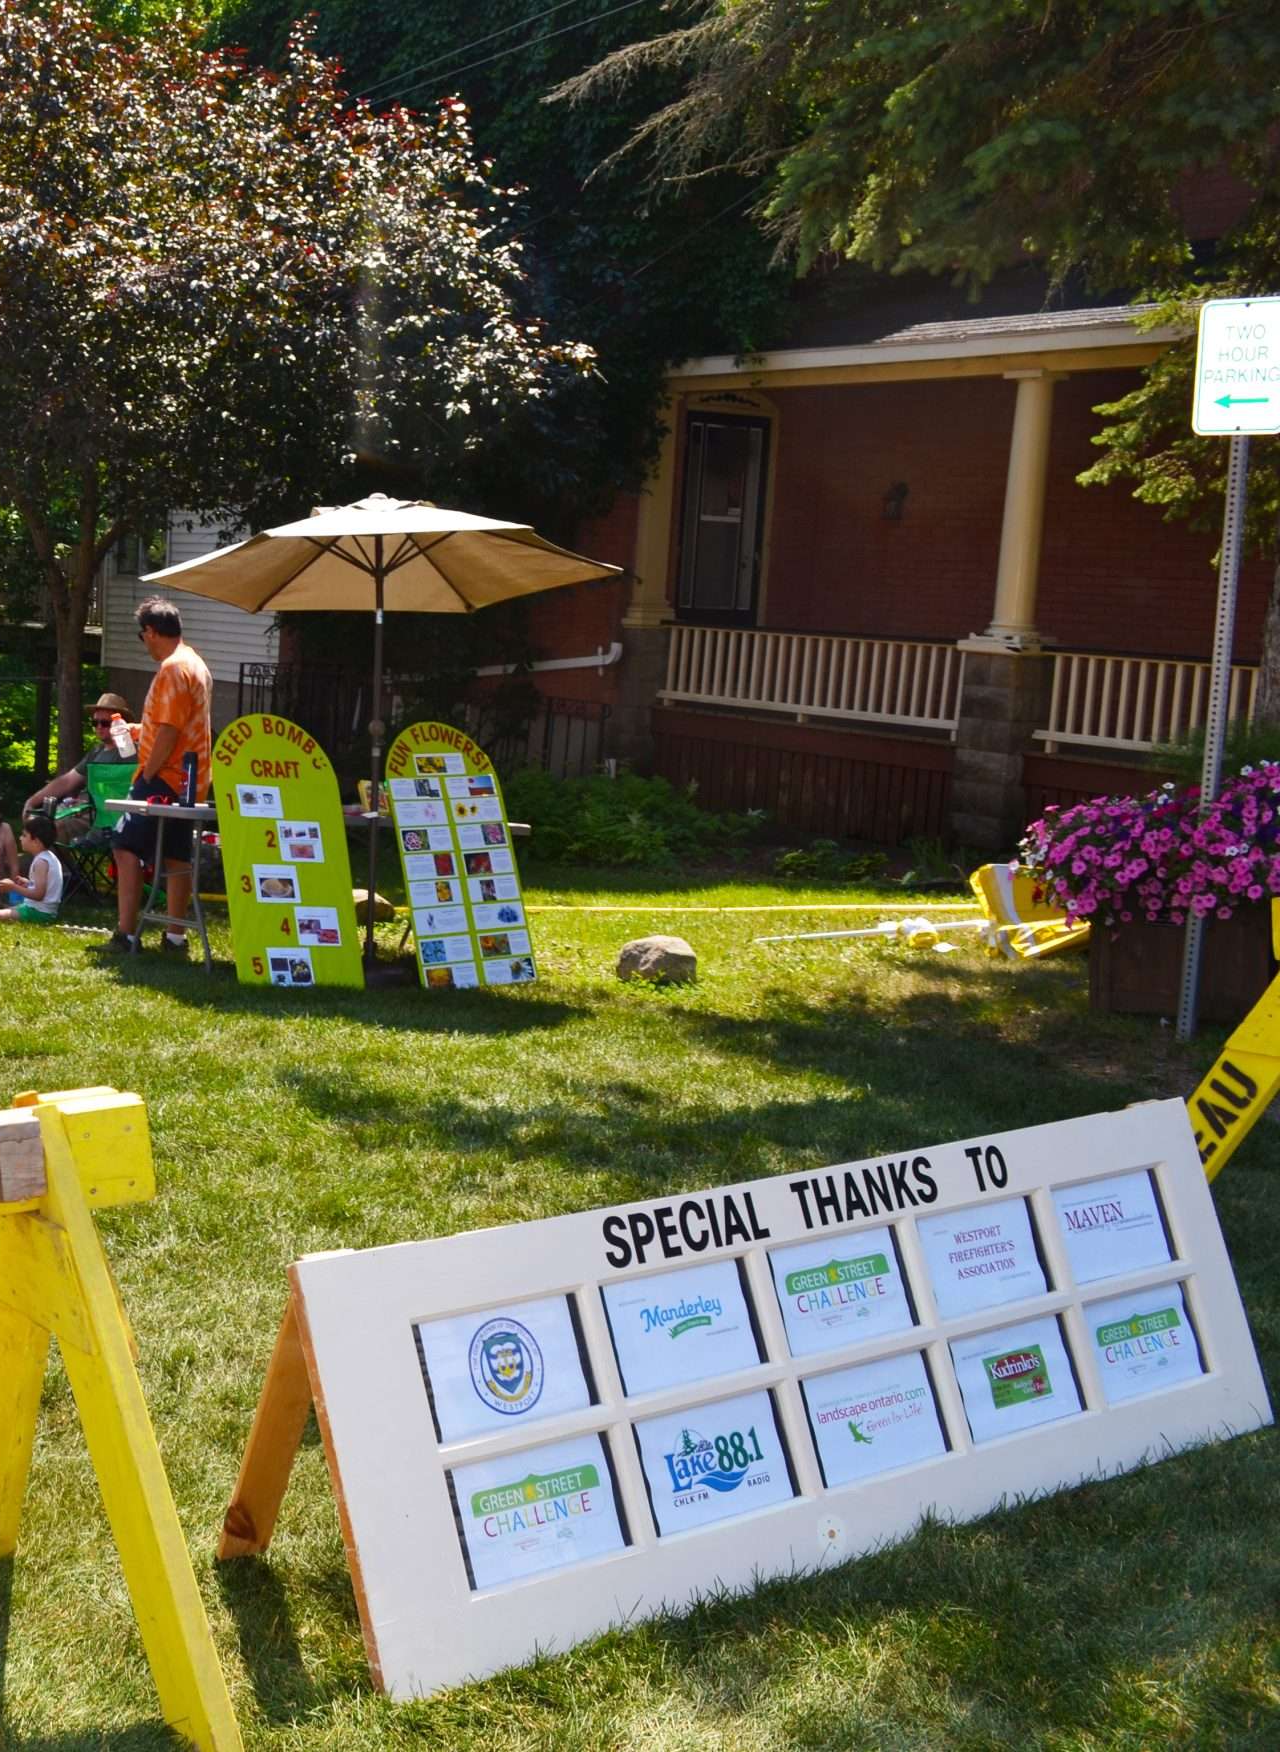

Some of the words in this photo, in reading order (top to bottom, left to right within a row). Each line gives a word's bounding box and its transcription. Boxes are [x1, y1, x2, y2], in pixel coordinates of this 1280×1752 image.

[1225, 323, 1266, 340] TWO
[1217, 345, 1269, 362] HOUR
[1204, 366, 1280, 384] PARKING
[216, 721, 252, 766] SEED
[389, 740, 413, 777] FUN
[410, 724, 490, 773] FLOWERS!
[250, 759, 300, 778] CRAFT
[226, 793, 235, 811] 1
[265, 830, 276, 848] 2
[241, 875, 252, 893] 3
[280, 918, 291, 936] 4
[252, 956, 264, 976] 5
[602, 1191, 769, 1269] SPECIAL
[789, 1155, 939, 1230] THANKS
[964, 1144, 1009, 1193] TO
[1064, 1201, 1125, 1231] MAVEN
[953, 1224, 1001, 1245] WESTPORT
[791, 1271, 829, 1291] GREEN
[837, 1260, 876, 1281] STREET
[957, 1257, 1016, 1281] ASSOCIATION
[797, 1277, 886, 1313] CHALLENGE
[640, 1295, 722, 1333] Manderley
[1102, 1323, 1132, 1343] GREEN
[1137, 1313, 1169, 1335] STREET
[1105, 1329, 1180, 1363] CHALLENGE
[663, 1451, 717, 1493] Lake
[714, 1425, 765, 1473] 88.1
[479, 1487, 524, 1513] GREEN
[535, 1471, 582, 1499] STREET
[746, 1474, 771, 1488] RADIO
[698, 1492, 709, 1501] FM
[483, 1491, 592, 1538] CHALLENGE
